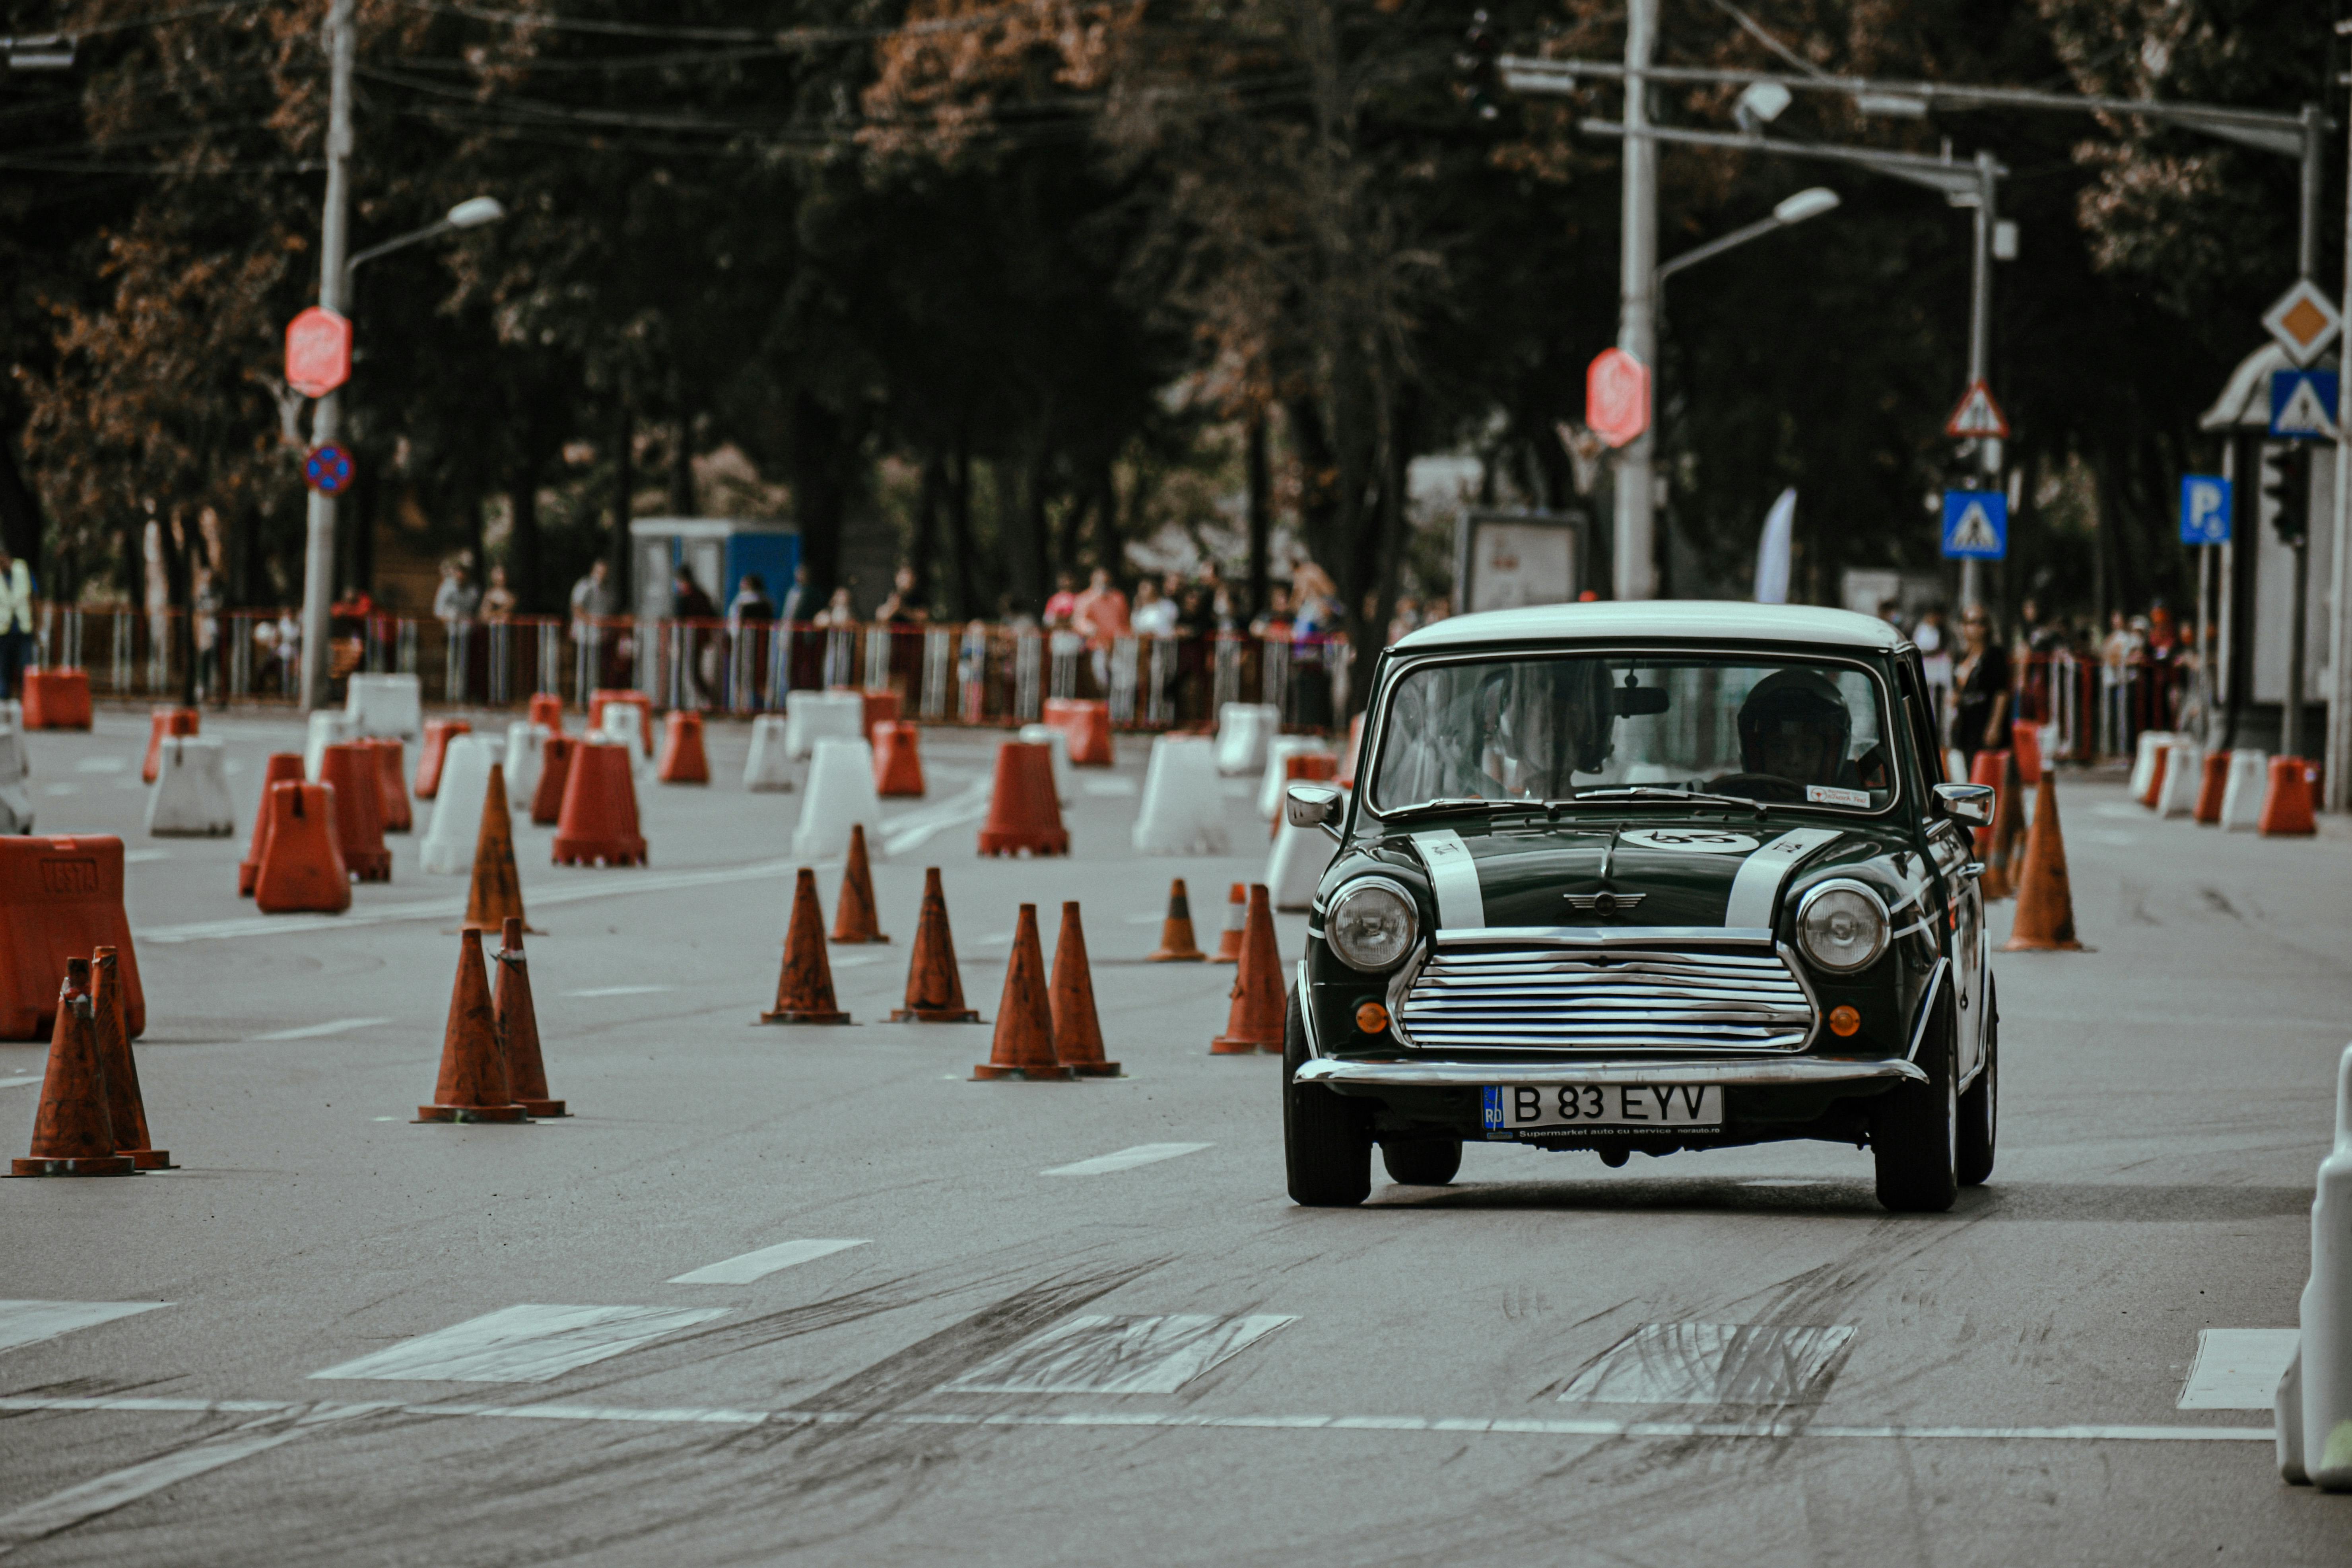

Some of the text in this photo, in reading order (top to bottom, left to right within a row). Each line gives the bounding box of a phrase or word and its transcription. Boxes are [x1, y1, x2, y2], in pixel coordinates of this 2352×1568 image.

[2191, 483, 2222, 528] P
[1486, 1108, 1502, 1123] RO
[1515, 1085, 1705, 1122] B 83 EYV
[1519, 1129, 1587, 1138] Supermarket
